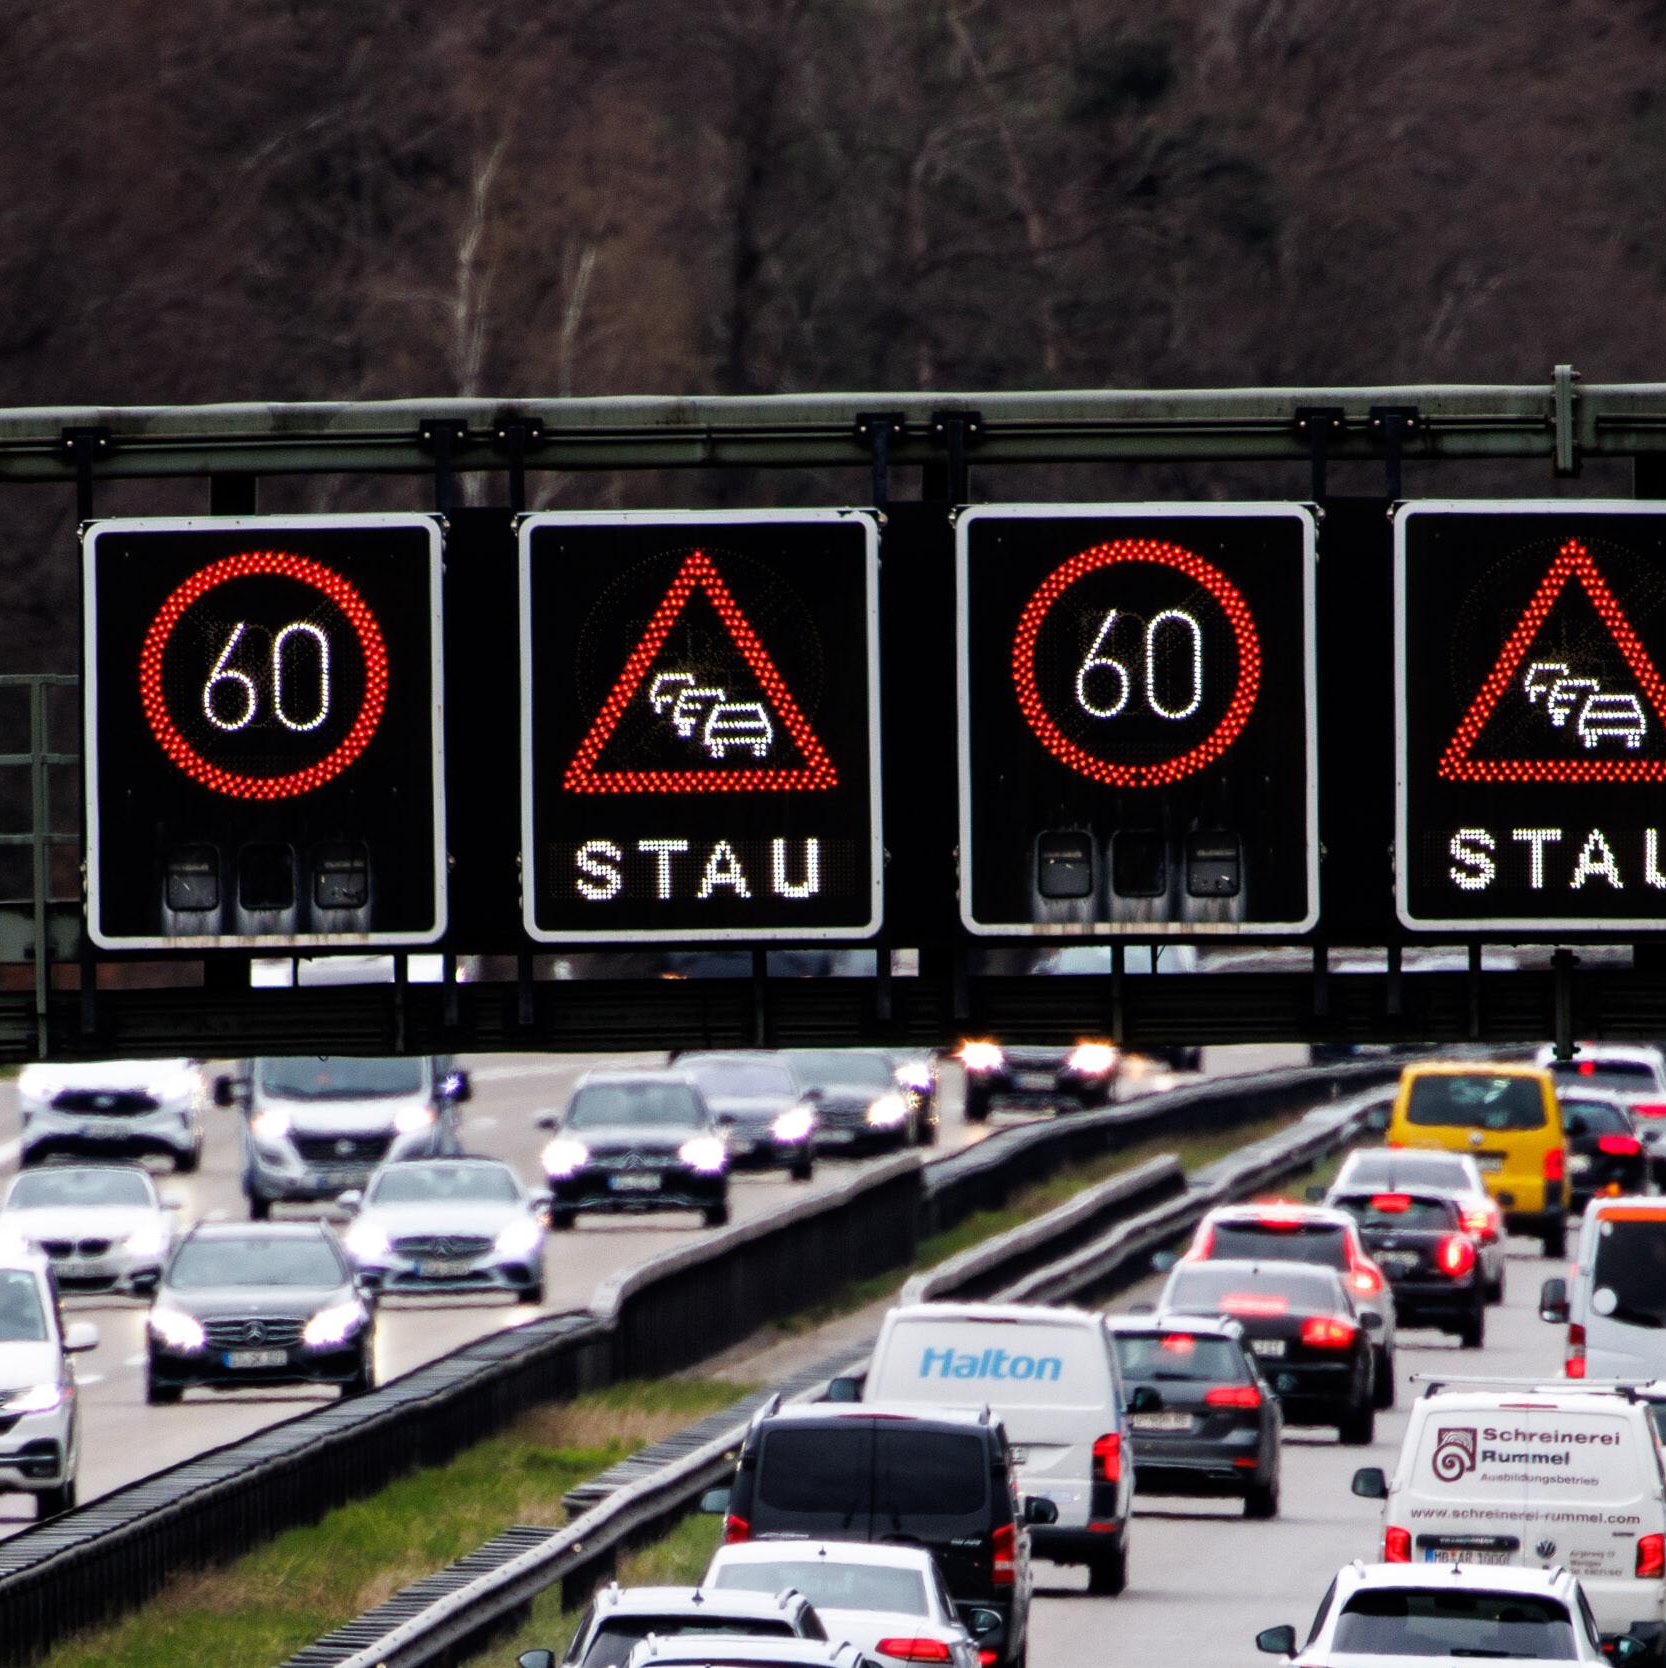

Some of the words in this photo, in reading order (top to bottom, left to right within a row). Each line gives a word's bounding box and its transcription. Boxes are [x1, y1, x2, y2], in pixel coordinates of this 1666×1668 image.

[1076, 609, 1202, 719] 60
[203, 623, 329, 732] 60
[576, 838, 820, 900] STAU
[920, 1347, 1063, 1381] Halton
[1482, 1427, 1621, 1446] Schreinerei
[1482, 1450, 1571, 1466] Rummel
[1480, 1472, 1600, 1487] Ausbildungsbetrieb
[1411, 1507, 1641, 1525] www.schreinerei-rummel.com
